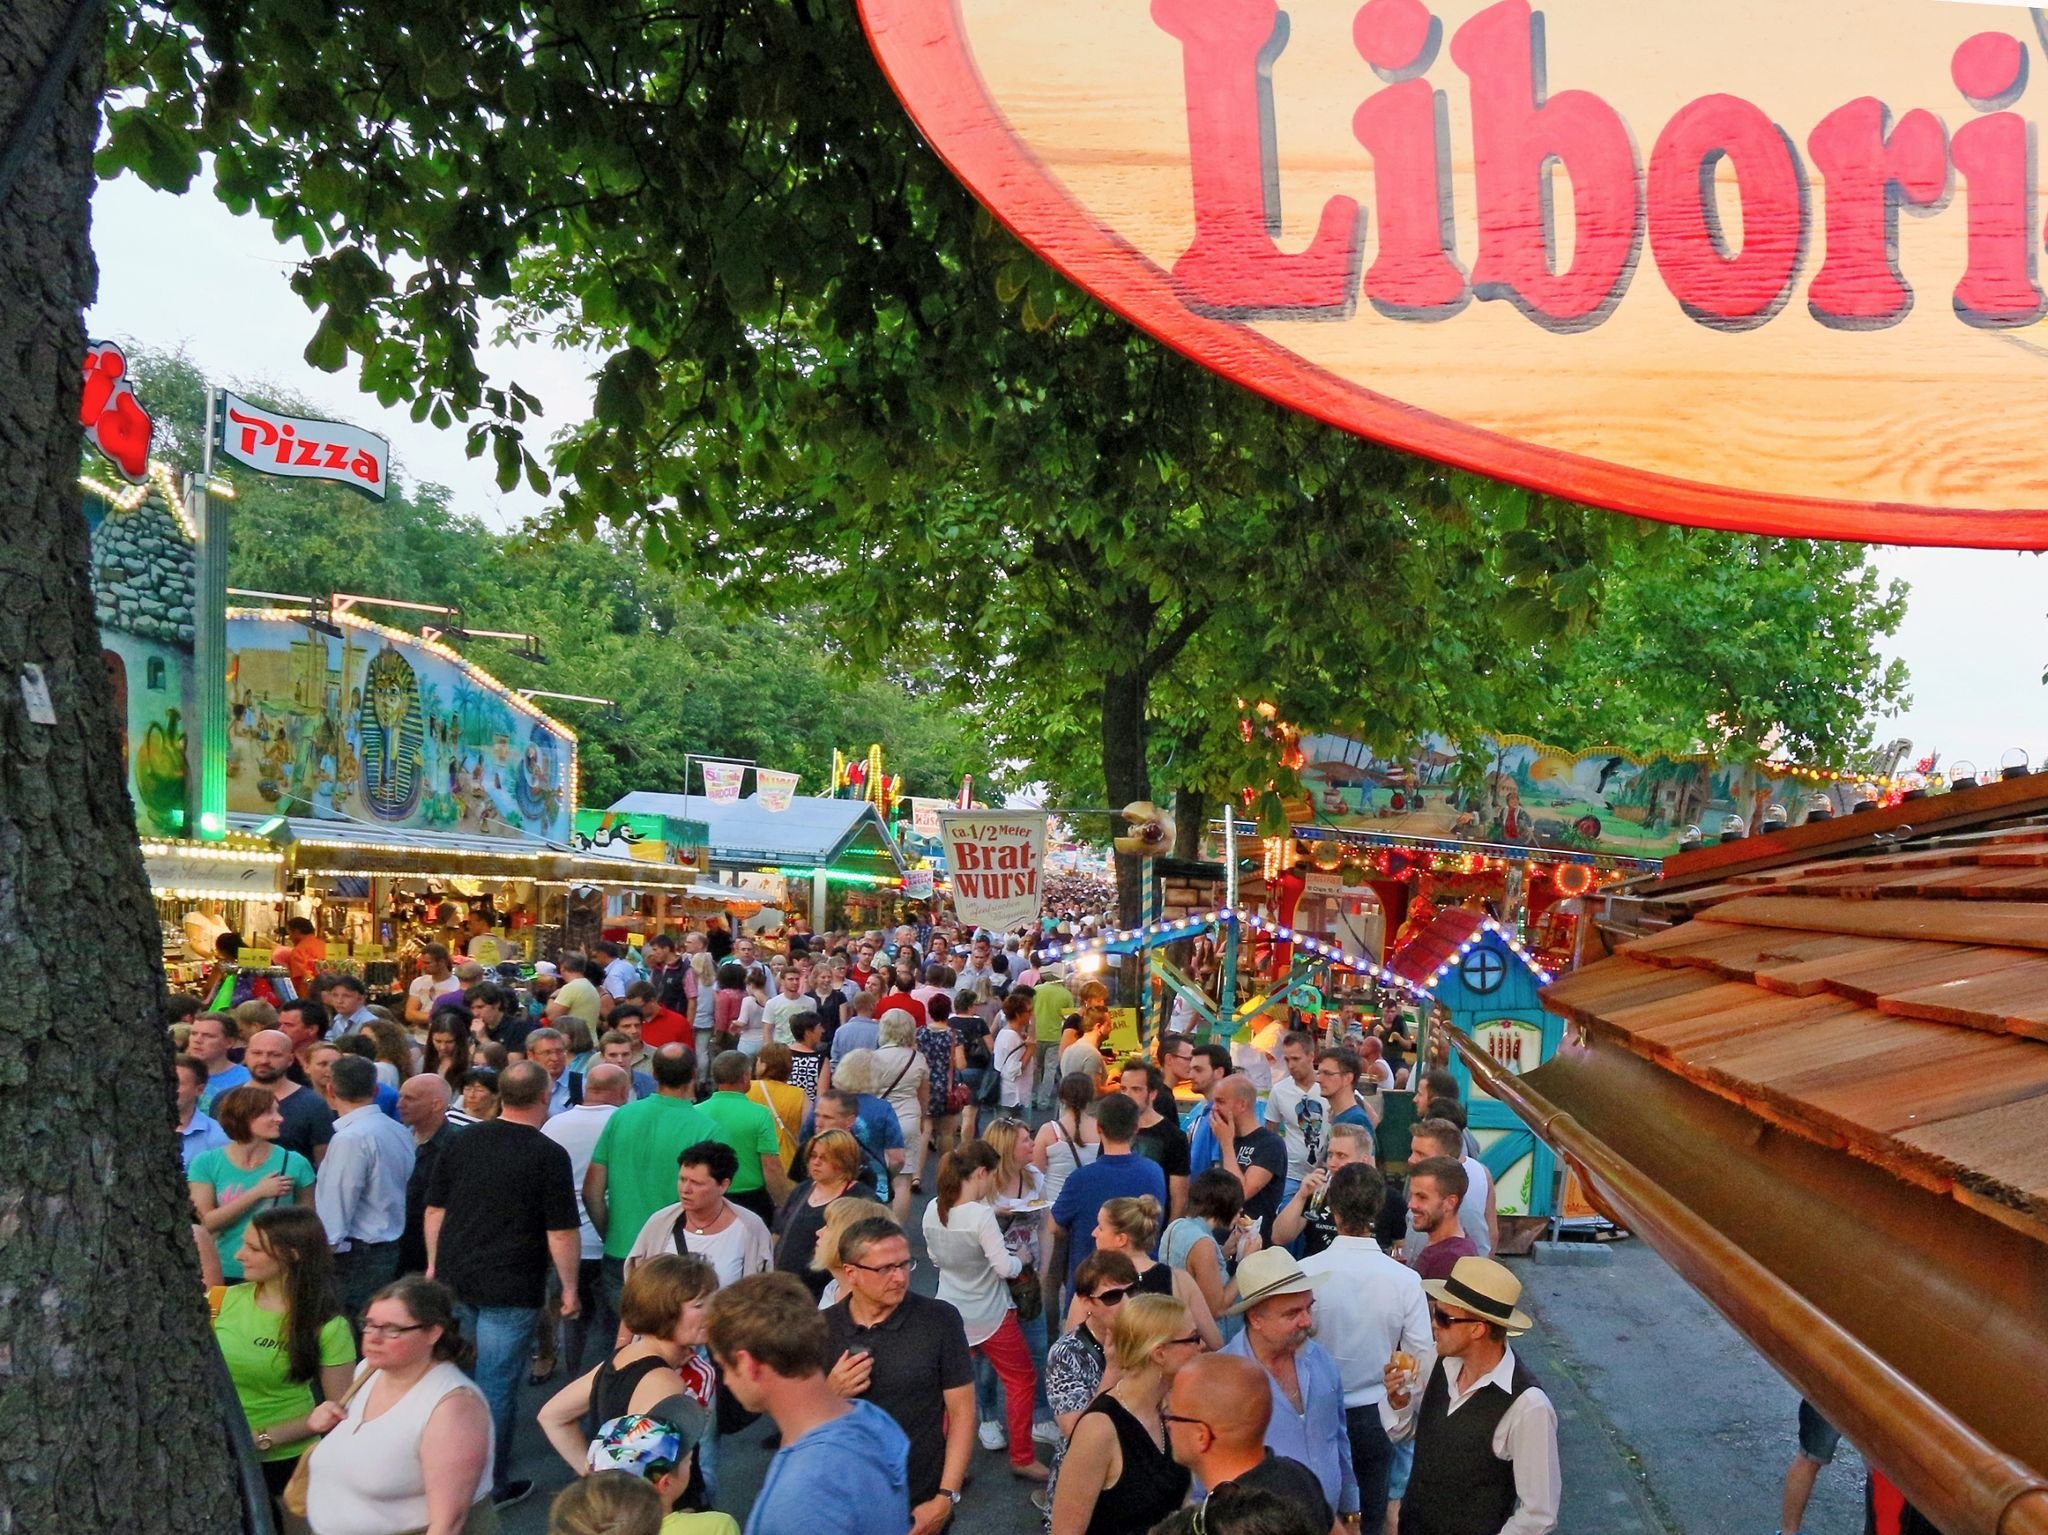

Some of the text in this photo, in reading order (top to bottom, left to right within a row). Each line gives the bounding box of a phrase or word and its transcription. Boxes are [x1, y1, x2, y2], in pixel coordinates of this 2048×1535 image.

[1148, 0, 2048, 333] Libori
[229, 407, 380, 484] Pizza
[953, 841, 1037, 870] Brat-
[969, 823, 998, 841] 1/2
[999, 825, 1032, 838] Meter
